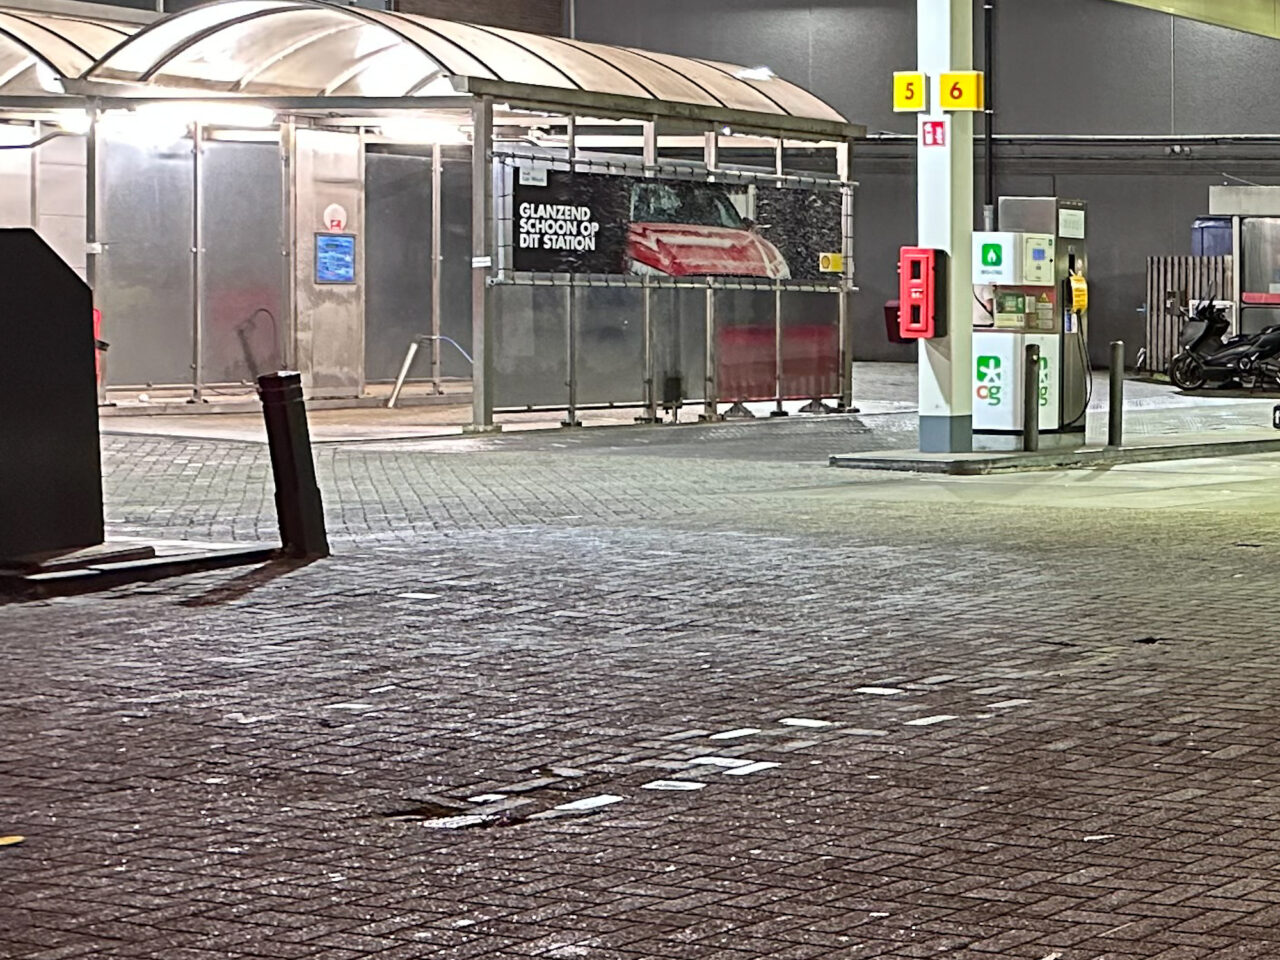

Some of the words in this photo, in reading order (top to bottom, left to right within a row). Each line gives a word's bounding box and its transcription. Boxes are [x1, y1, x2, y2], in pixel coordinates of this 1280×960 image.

[905, 82, 914, 100] 5
[950, 82, 963, 100] 6
[519, 202, 591, 221] GLANZEND
[519, 218, 577, 235] SCHOON
[580, 221, 600, 237] OP
[520, 233, 540, 249] DIT
[543, 234, 596, 251] STATION
